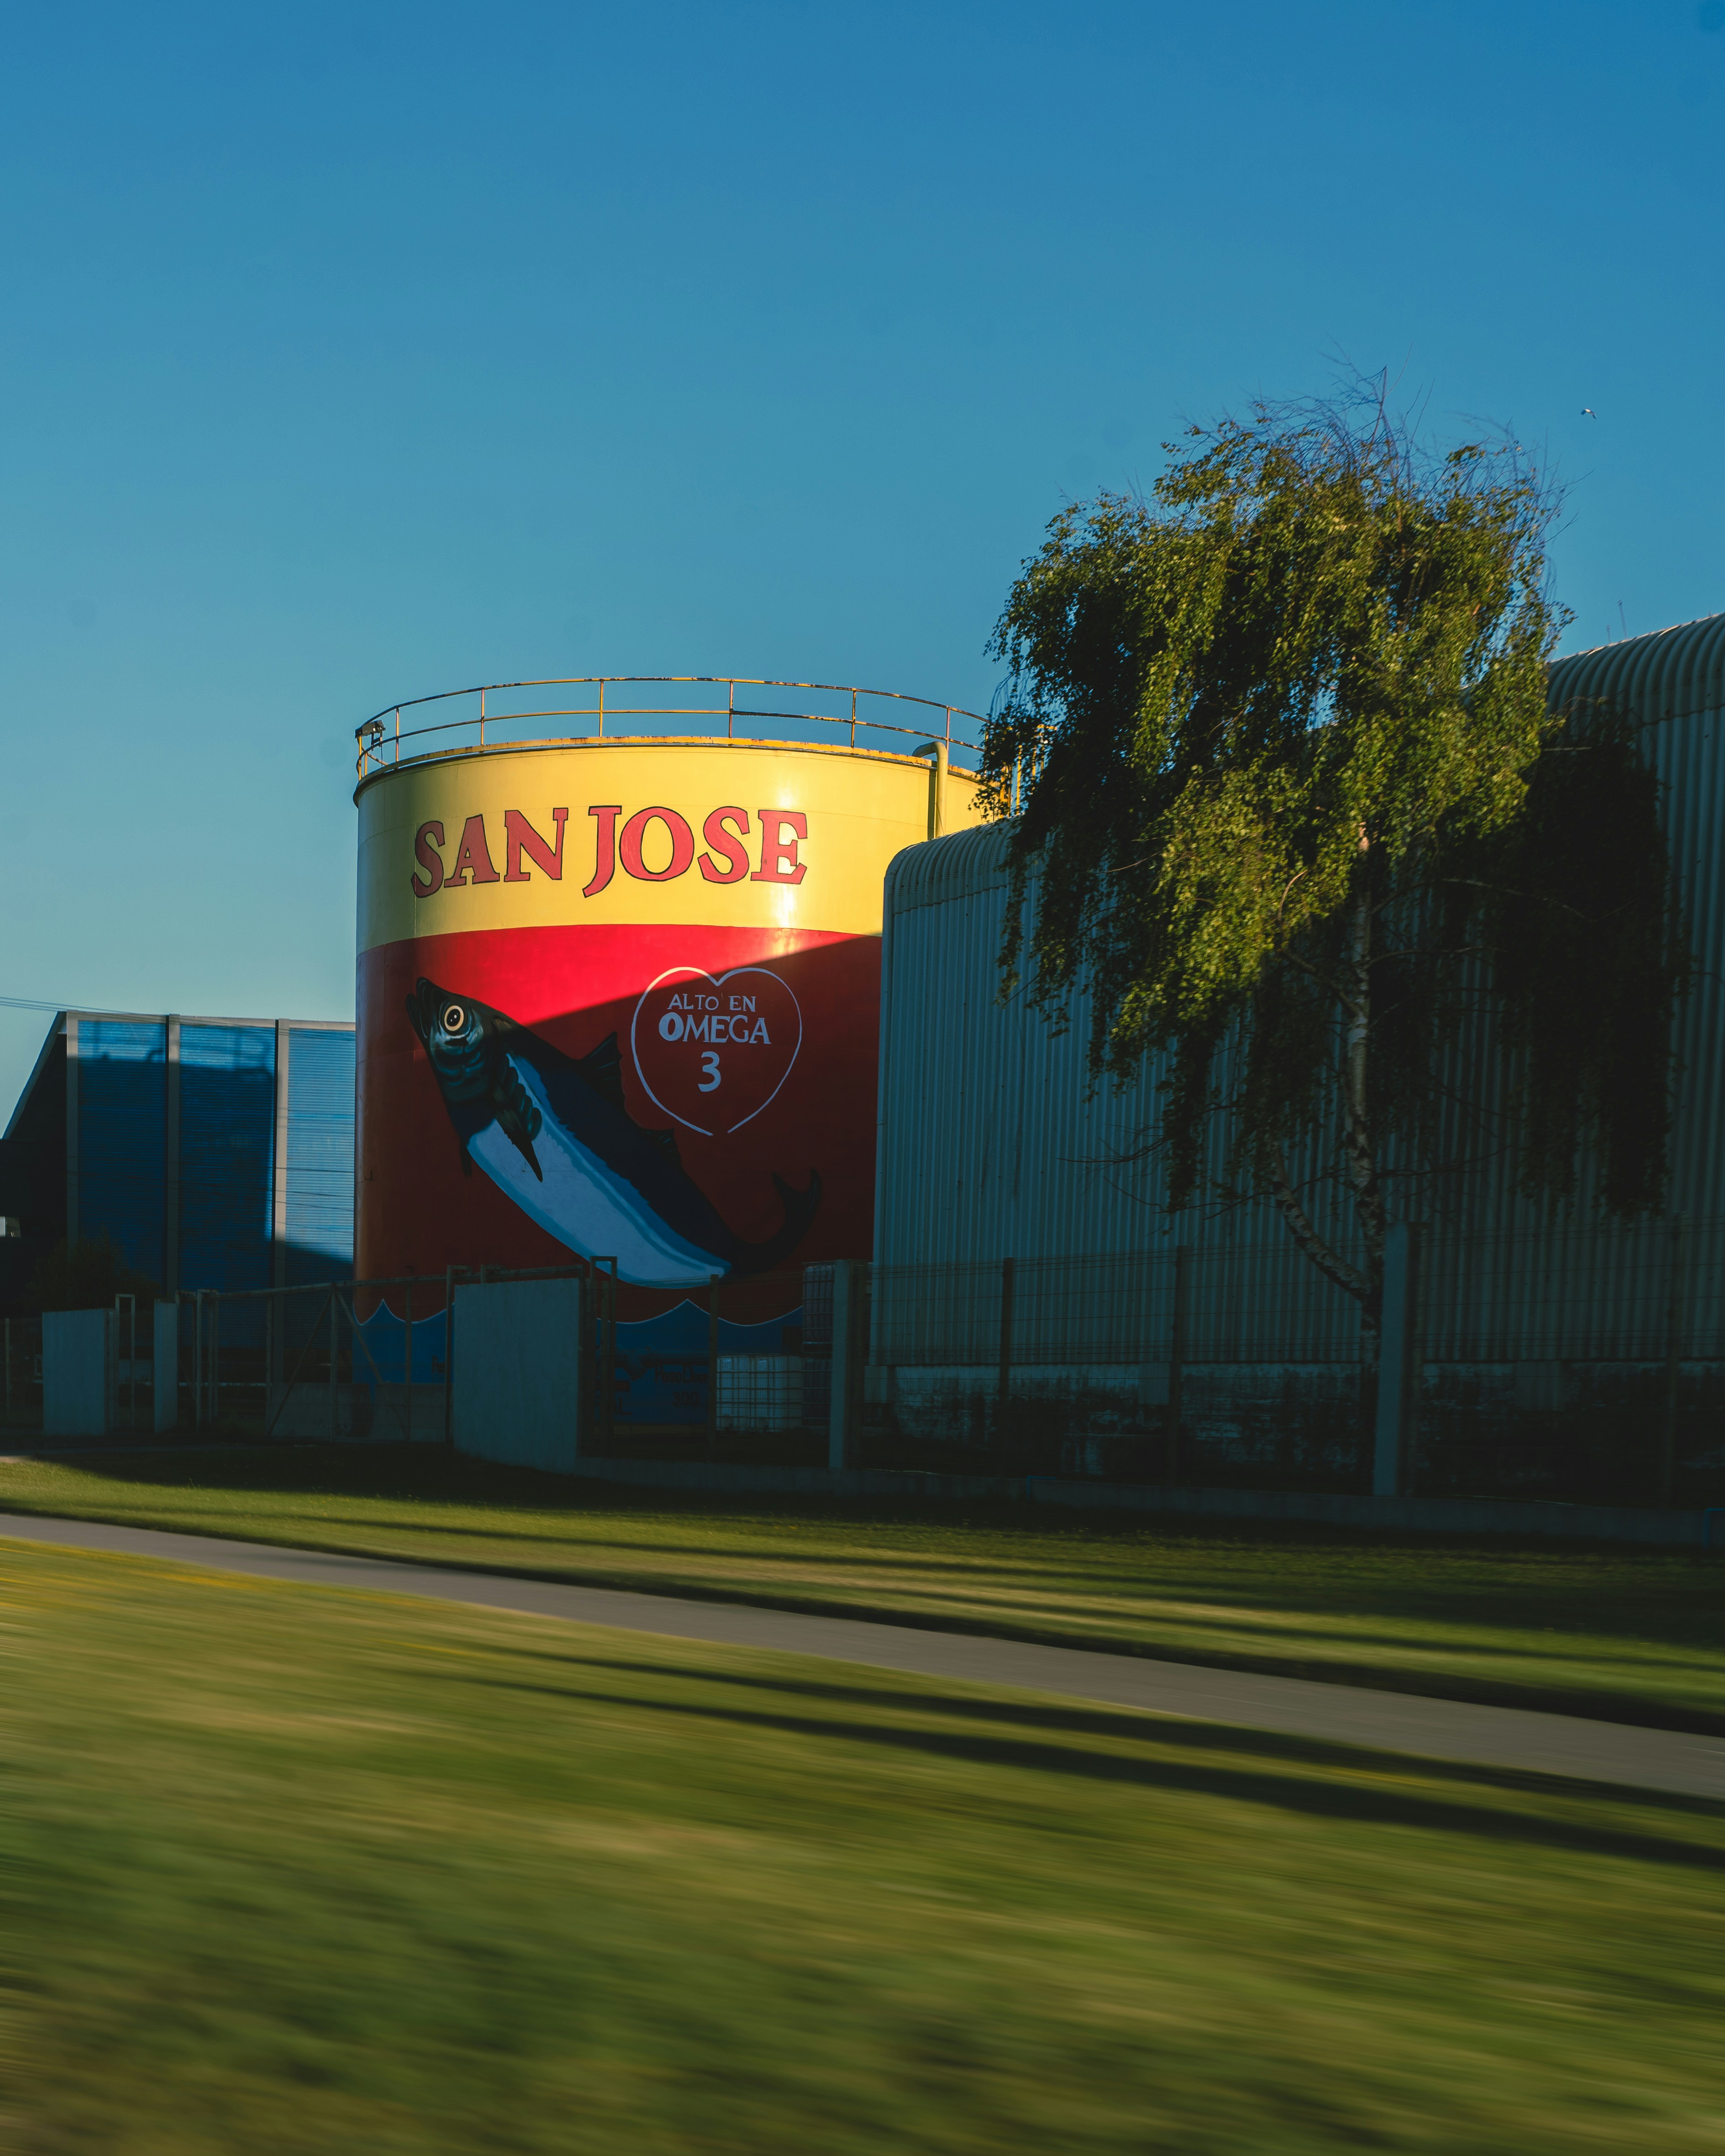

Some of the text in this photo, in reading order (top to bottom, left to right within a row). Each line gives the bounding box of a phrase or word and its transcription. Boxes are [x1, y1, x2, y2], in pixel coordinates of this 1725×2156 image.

[410, 805, 808, 898] SAN JOSE
[667, 994, 756, 1012] ALTO EN
[658, 1012, 772, 1044] OMEGA
[698, 1051, 721, 1092] 3
[673, 1391, 699, 1407] 300
